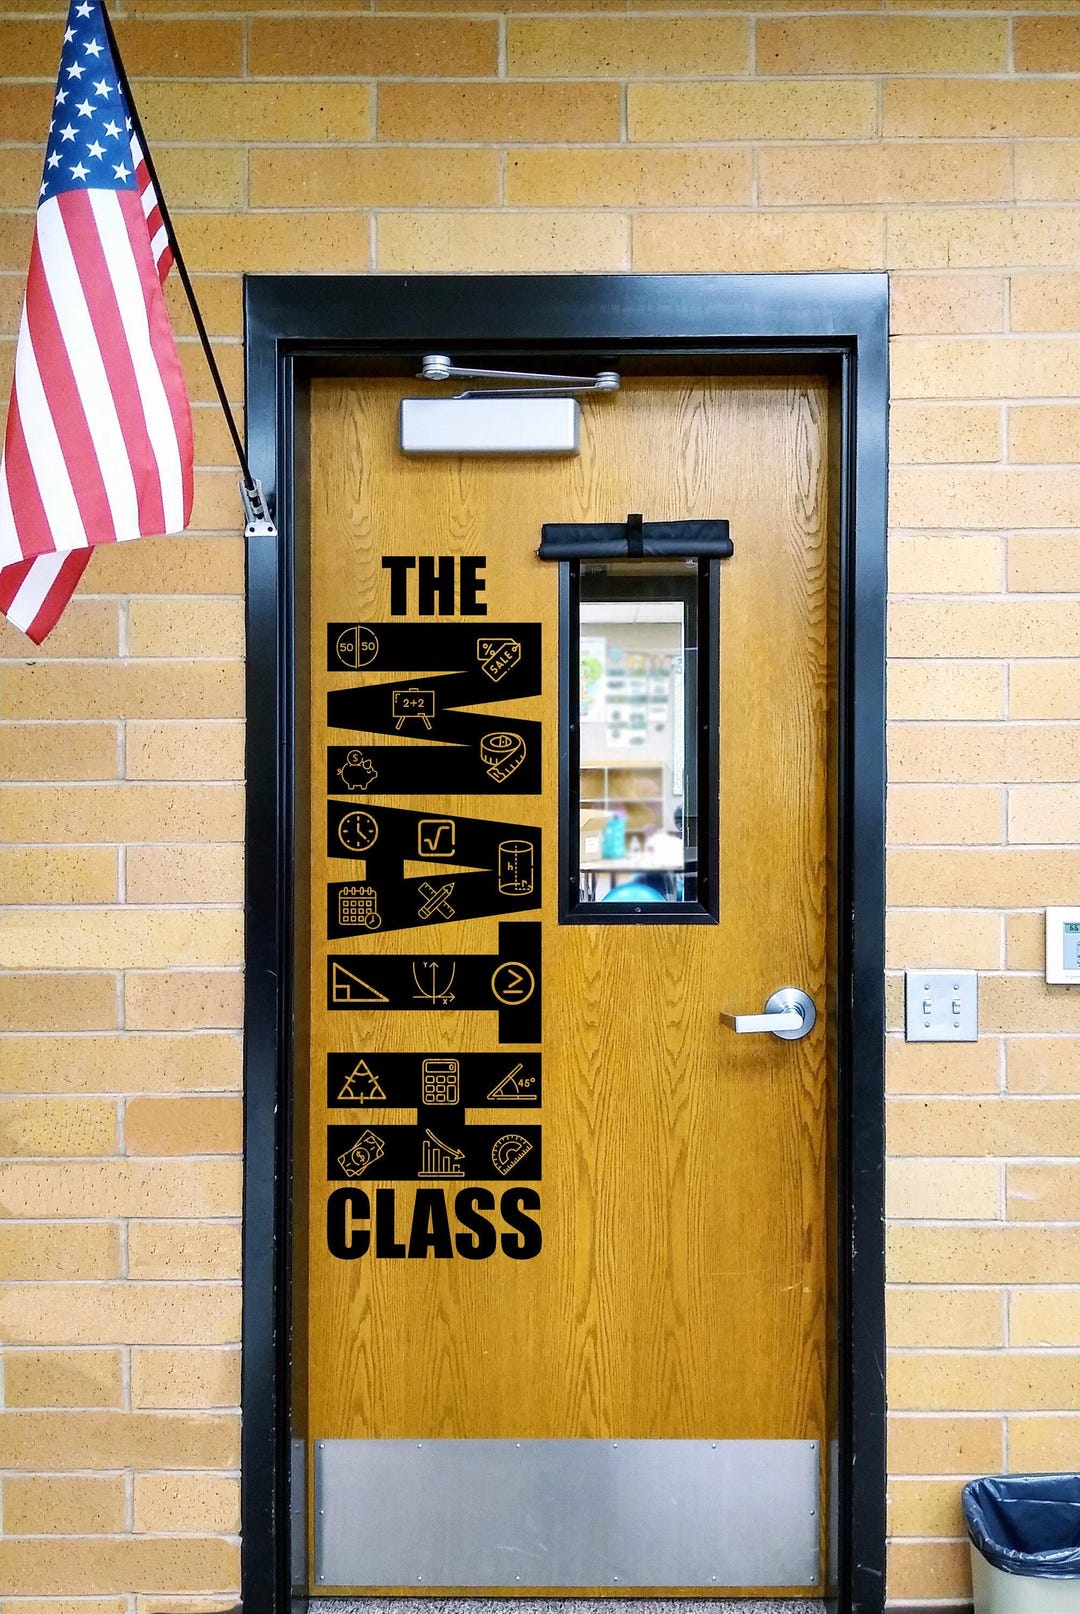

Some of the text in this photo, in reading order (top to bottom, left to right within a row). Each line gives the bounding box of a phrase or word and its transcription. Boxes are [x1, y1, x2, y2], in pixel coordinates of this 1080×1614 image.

[382, 556, 487, 616] THE
[340, 641, 375, 652] 50 50
[490, 650, 513, 675] SALE
[403, 698, 425, 708] 2+2
[327, 622, 542, 1181] MATH
[327, 1187, 542, 1260] CLASS
